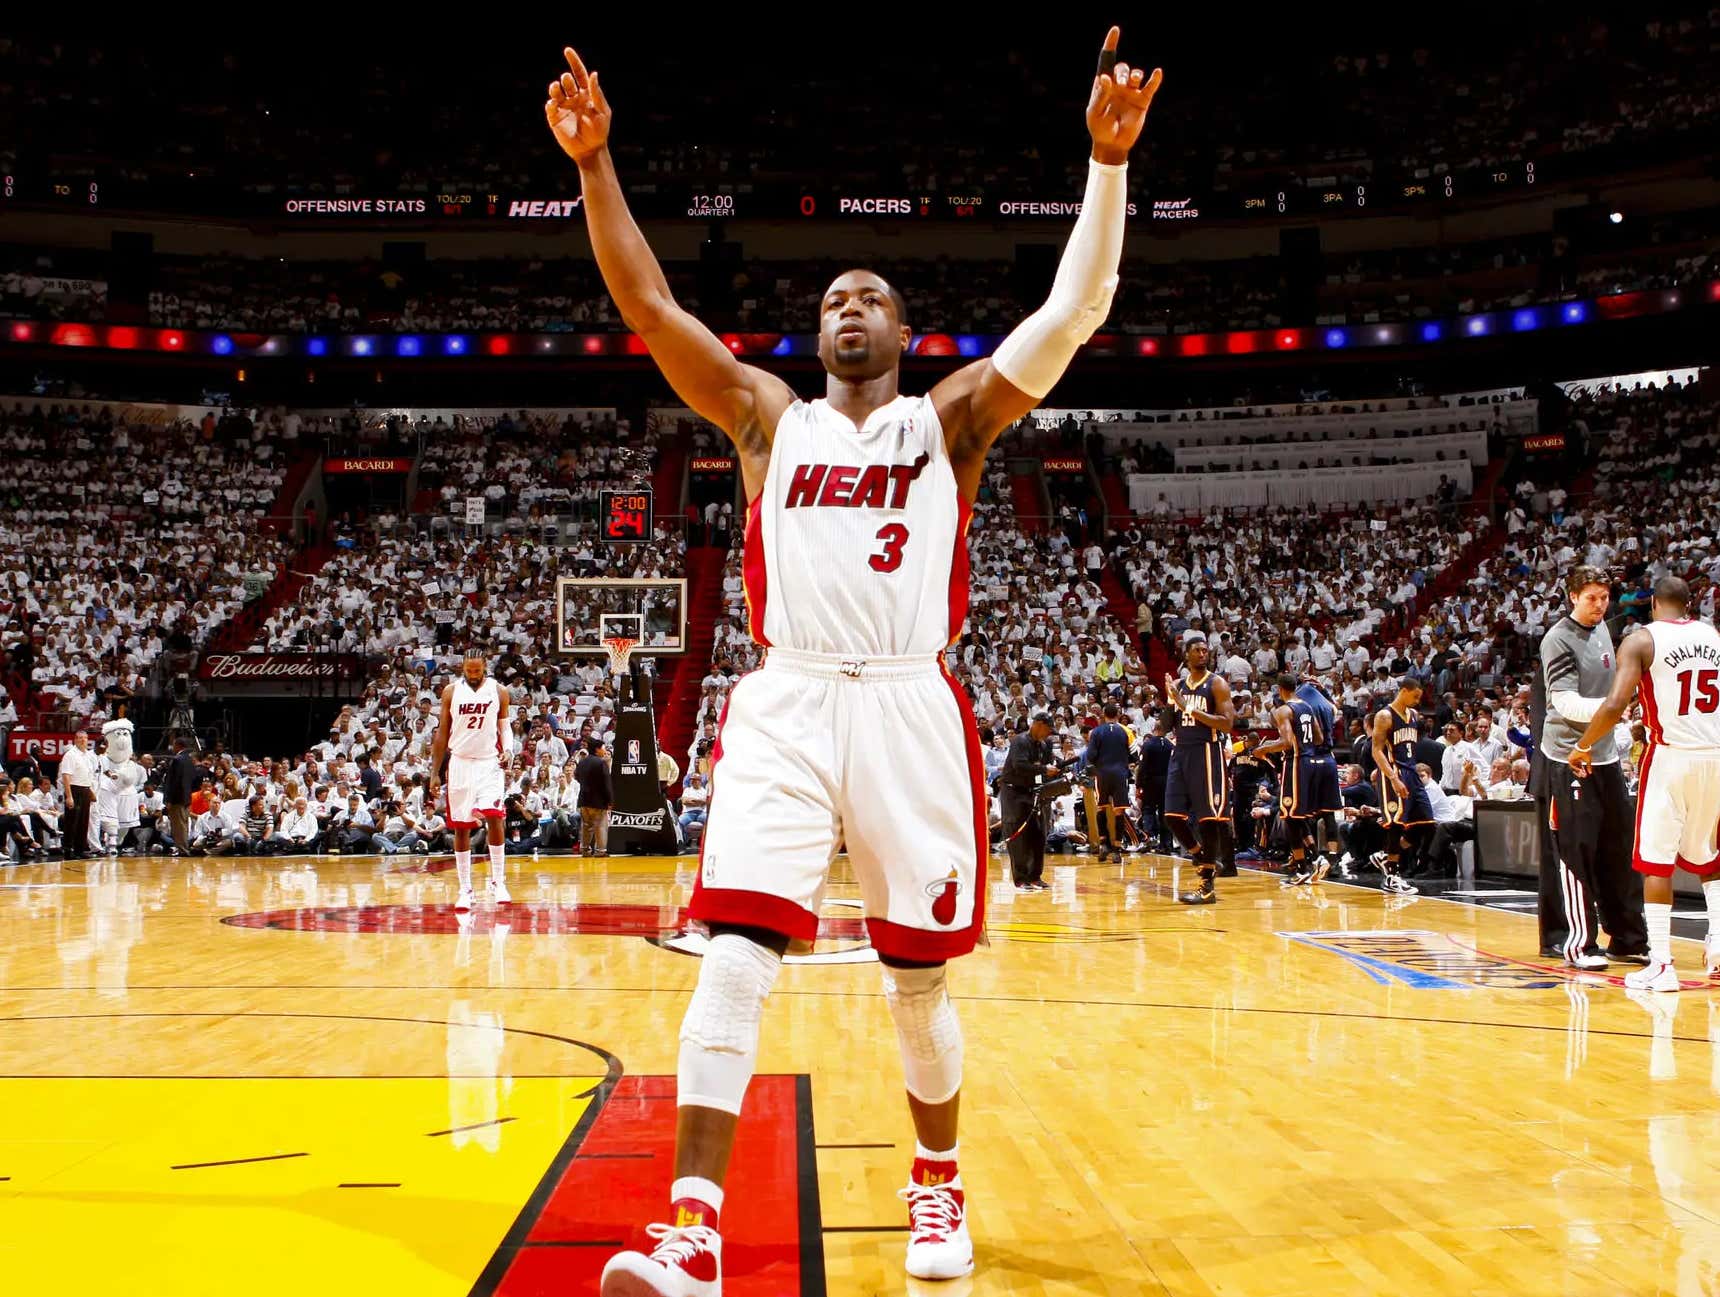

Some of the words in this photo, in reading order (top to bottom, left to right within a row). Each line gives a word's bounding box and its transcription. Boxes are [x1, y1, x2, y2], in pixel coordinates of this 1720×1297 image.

[286, 200, 371, 213] OFFENSIVE
[375, 200, 426, 213] STATS
[508, 196, 583, 217] HEAT
[692, 195, 733, 208] 12:00
[800, 195, 816, 216] 0
[840, 198, 911, 213] PACERS
[1154, 198, 1192, 209] HEAT
[688, 208, 728, 216] QUARTER
[730, 208, 735, 216] 1
[1152, 209, 1199, 219] PACERS
[344, 460, 394, 470] BACARDI
[693, 460, 731, 469] BACARDI
[1043, 461, 1082, 469] BACARDI
[784, 451, 929, 509] HEAT
[611, 496, 646, 510] 12:00
[608, 511, 643, 537] 24
[868, 522, 910, 574] 3
[1664, 644, 1720, 668] CHALMERS
[1677, 669, 1720, 716] 15
[458, 700, 493, 715] HEAT
[467, 716, 485, 729] 21
[1301, 723, 1313, 744] 24
[12, 739, 96, 756] TOSH
[1406, 743, 1413, 758] 3
[621, 766, 636, 775] NBA
[637, 766, 648, 775] TV
[610, 813, 663, 826] PLAYOFFS
